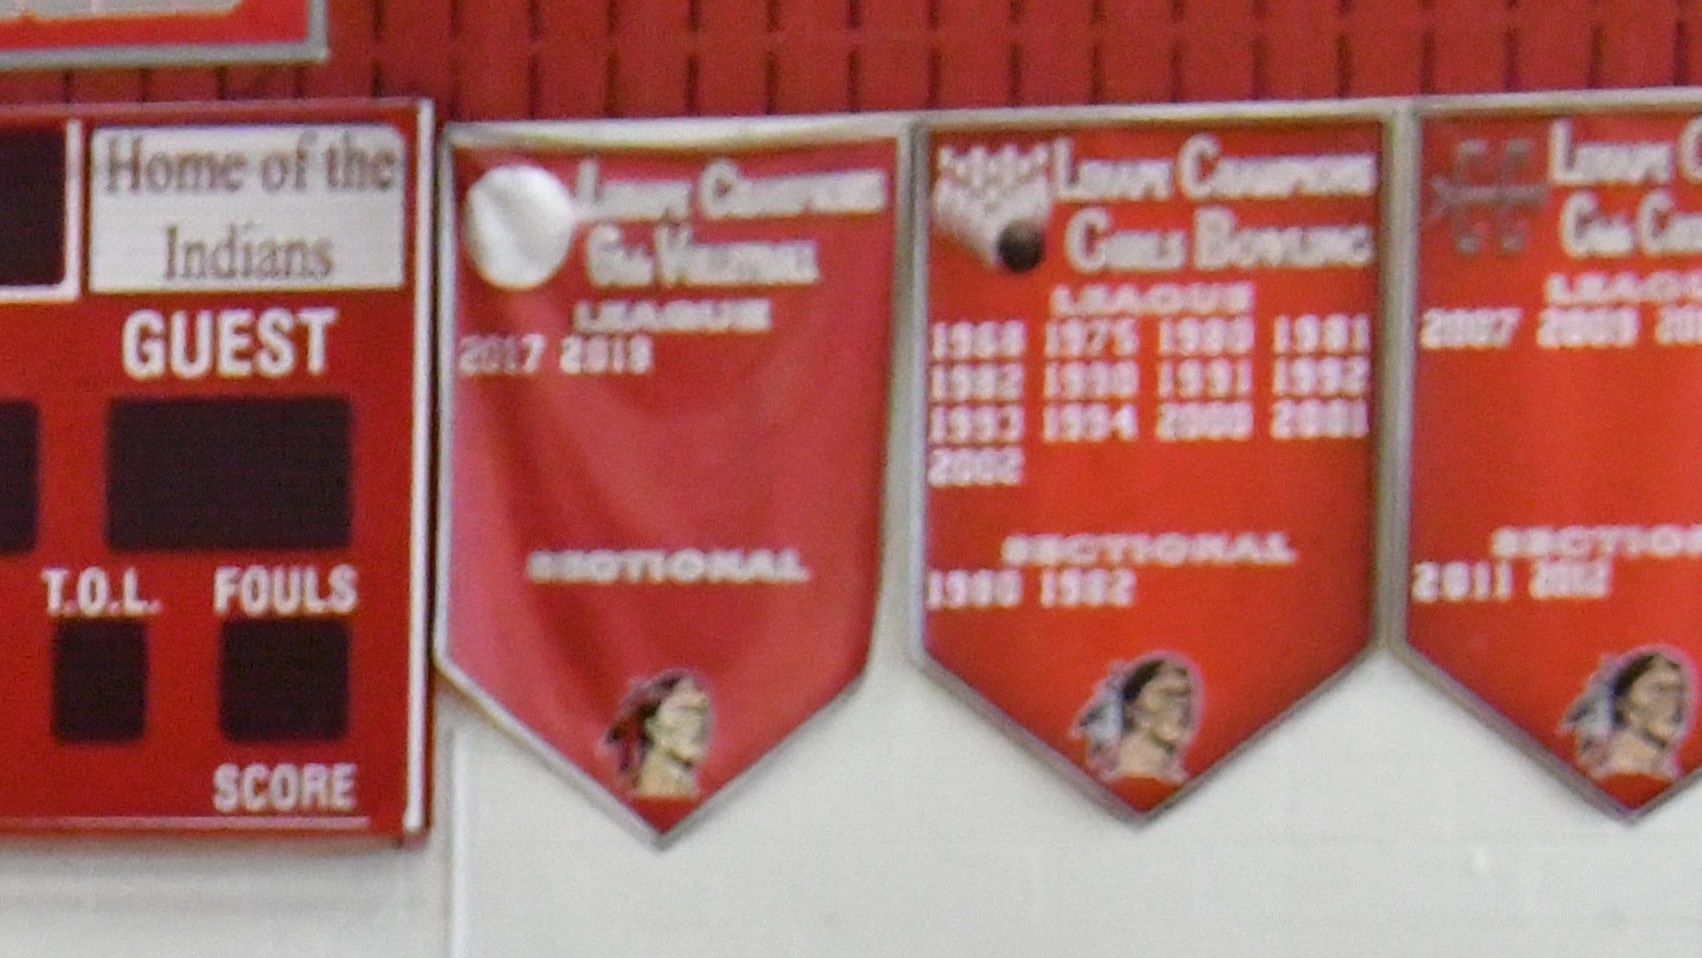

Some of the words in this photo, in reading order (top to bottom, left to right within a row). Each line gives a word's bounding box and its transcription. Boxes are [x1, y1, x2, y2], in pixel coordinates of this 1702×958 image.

[105, 135, 246, 193] Home
[259, 130, 318, 192] of
[325, 130, 397, 192] the
[165, 221, 334, 281] Indians
[573, 299, 771, 332] LEAGUE
[1050, 282, 1255, 317] LEAGUE
[122, 307, 338, 381] GUEST
[527, 549, 809, 585] SECTIONAL
[1002, 531, 1295, 567] SECTIONAL
[42, 567, 160, 616] T.O.L.
[213, 565, 358, 614] FOULS
[213, 763, 356, 812] SCORE
